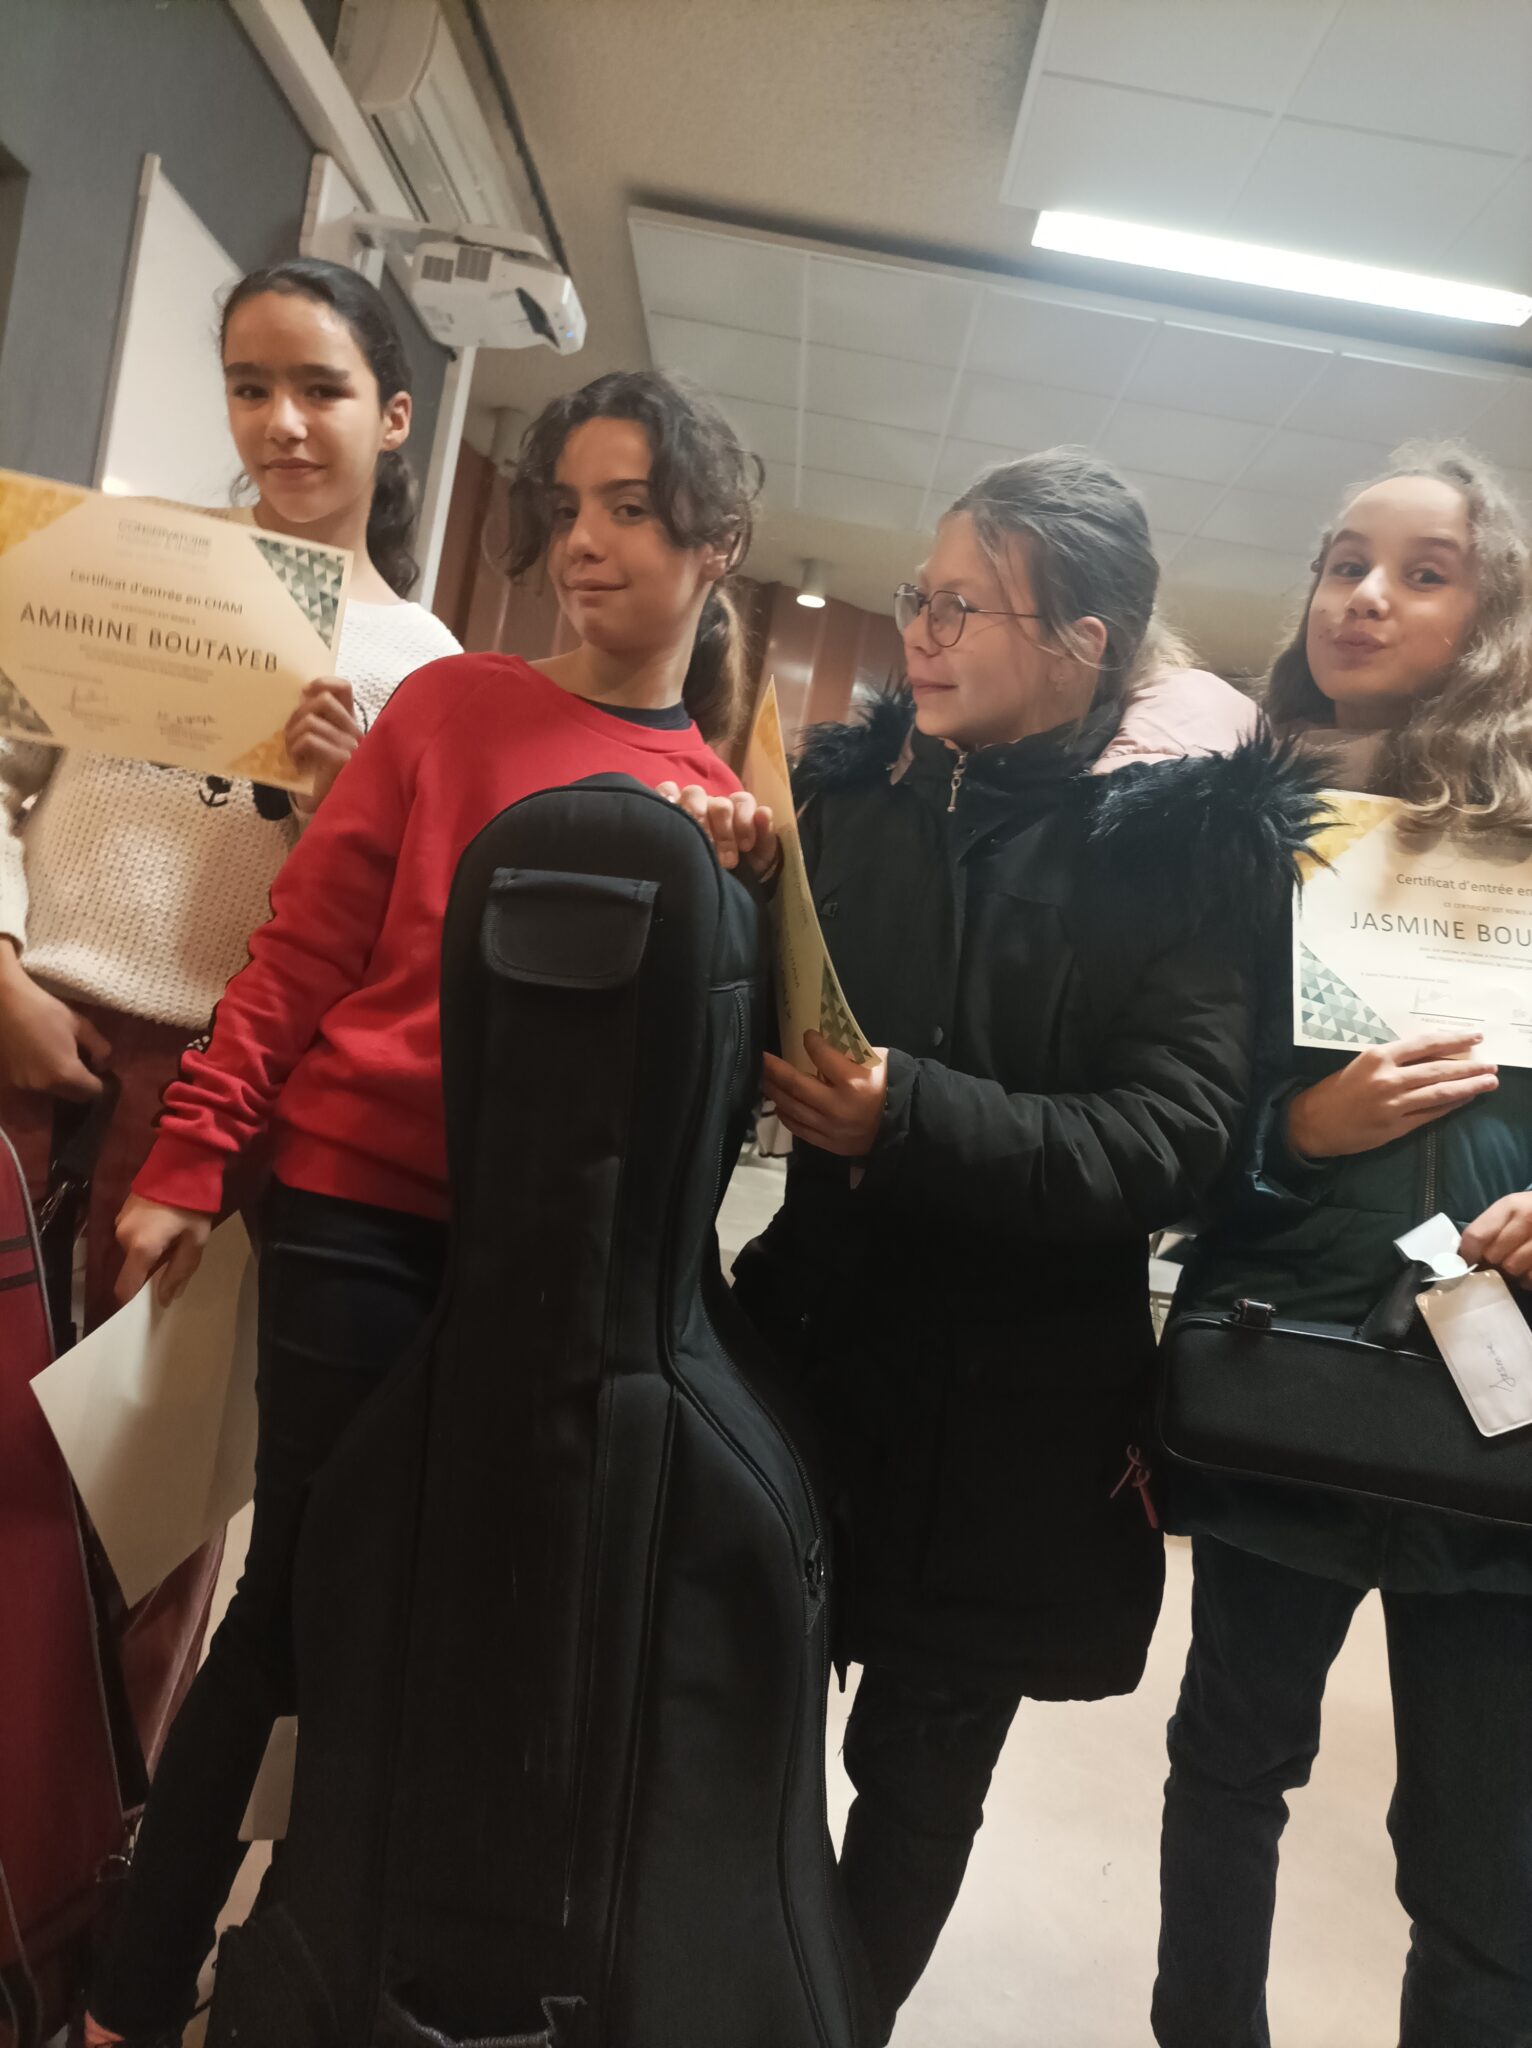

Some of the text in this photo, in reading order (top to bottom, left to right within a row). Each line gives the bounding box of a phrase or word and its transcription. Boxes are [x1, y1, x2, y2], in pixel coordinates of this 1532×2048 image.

[70, 569, 126, 591] Certificat
[130, 579, 182, 602] d'entrée
[185, 593, 201, 605] en
[204, 597, 244, 615] CHAM
[20, 601, 138, 646] AMBRINE
[149, 627, 278, 673] BOUTAYEB
[1396, 873, 1456, 890] Certificat
[1458, 880, 1513, 895] d'entrée
[1350, 911, 1466, 941] JASMINE
